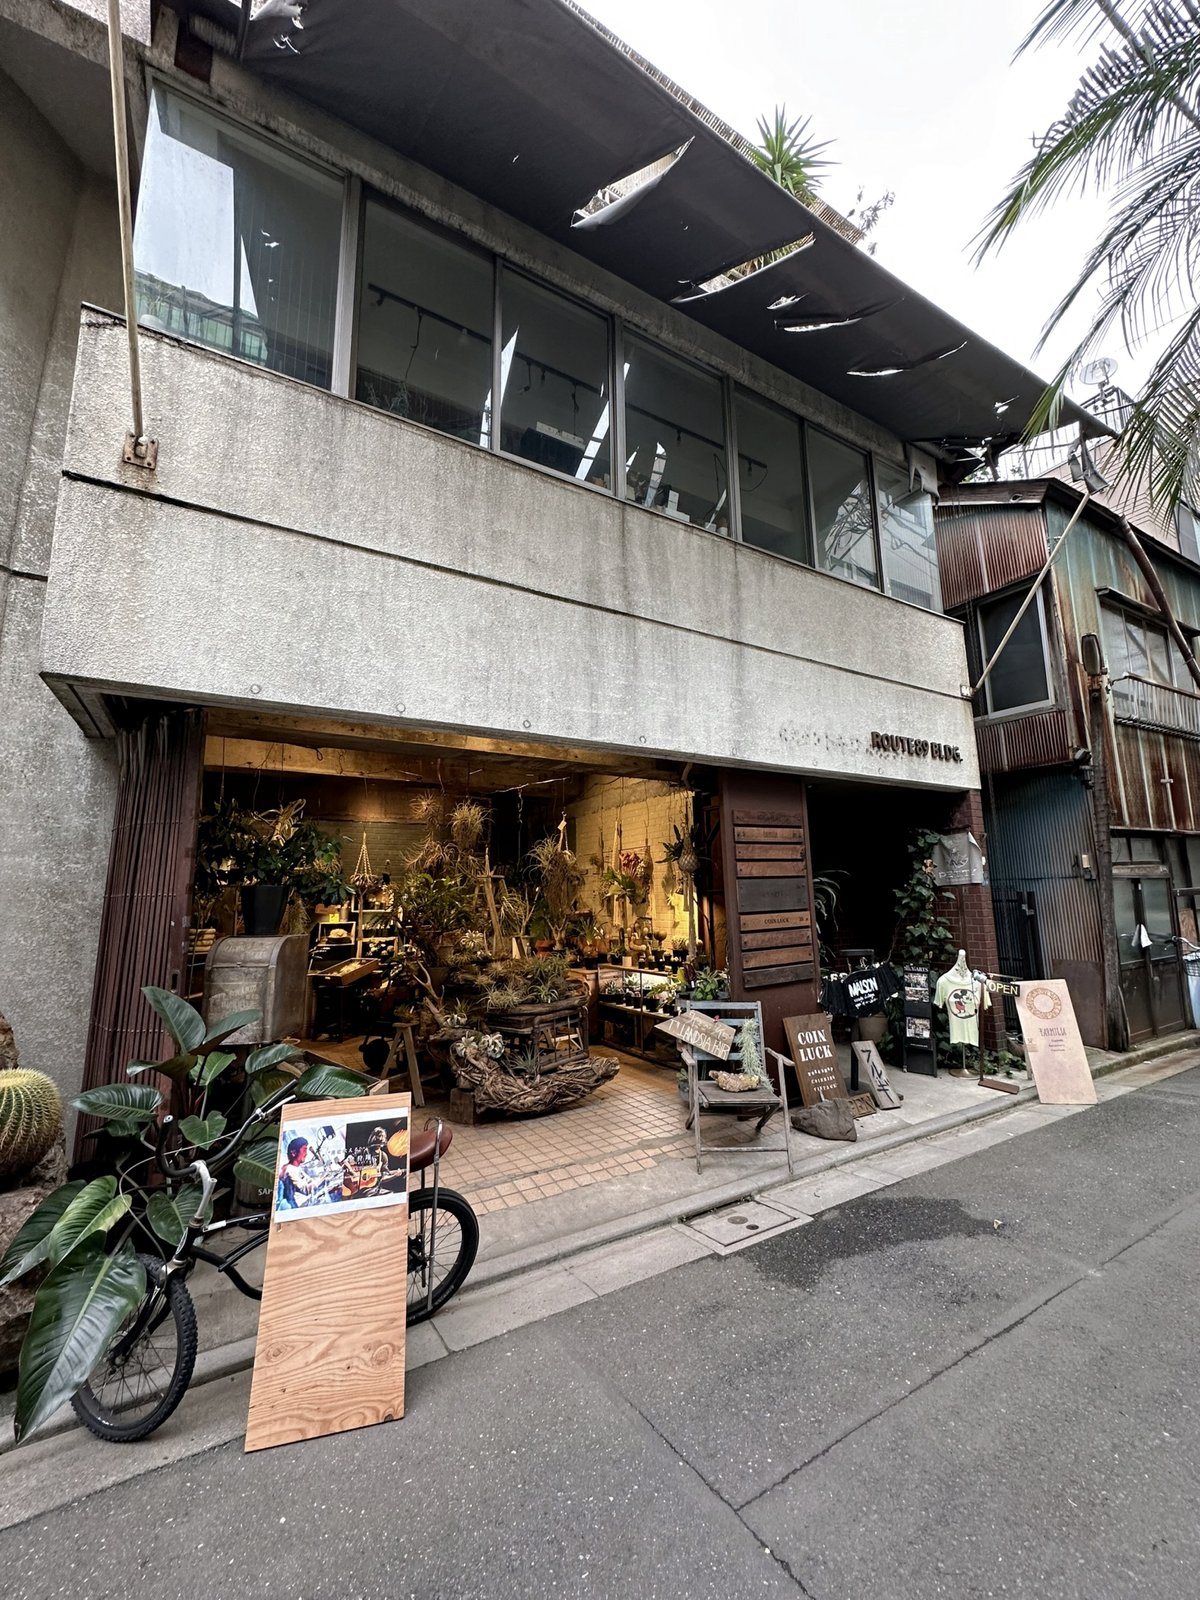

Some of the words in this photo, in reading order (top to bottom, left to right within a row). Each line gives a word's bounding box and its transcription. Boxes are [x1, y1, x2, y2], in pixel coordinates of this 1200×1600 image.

[871, 731, 929, 757] ROUTE89
[930, 742, 963, 764] BLDG.
[848, 977, 879, 998] MAISON
[988, 982, 1018, 995] OPEN
[797, 1029, 827, 1046] COIN
[799, 1045, 833, 1062] LUCK
[861, 1049, 896, 1105] フルギ
